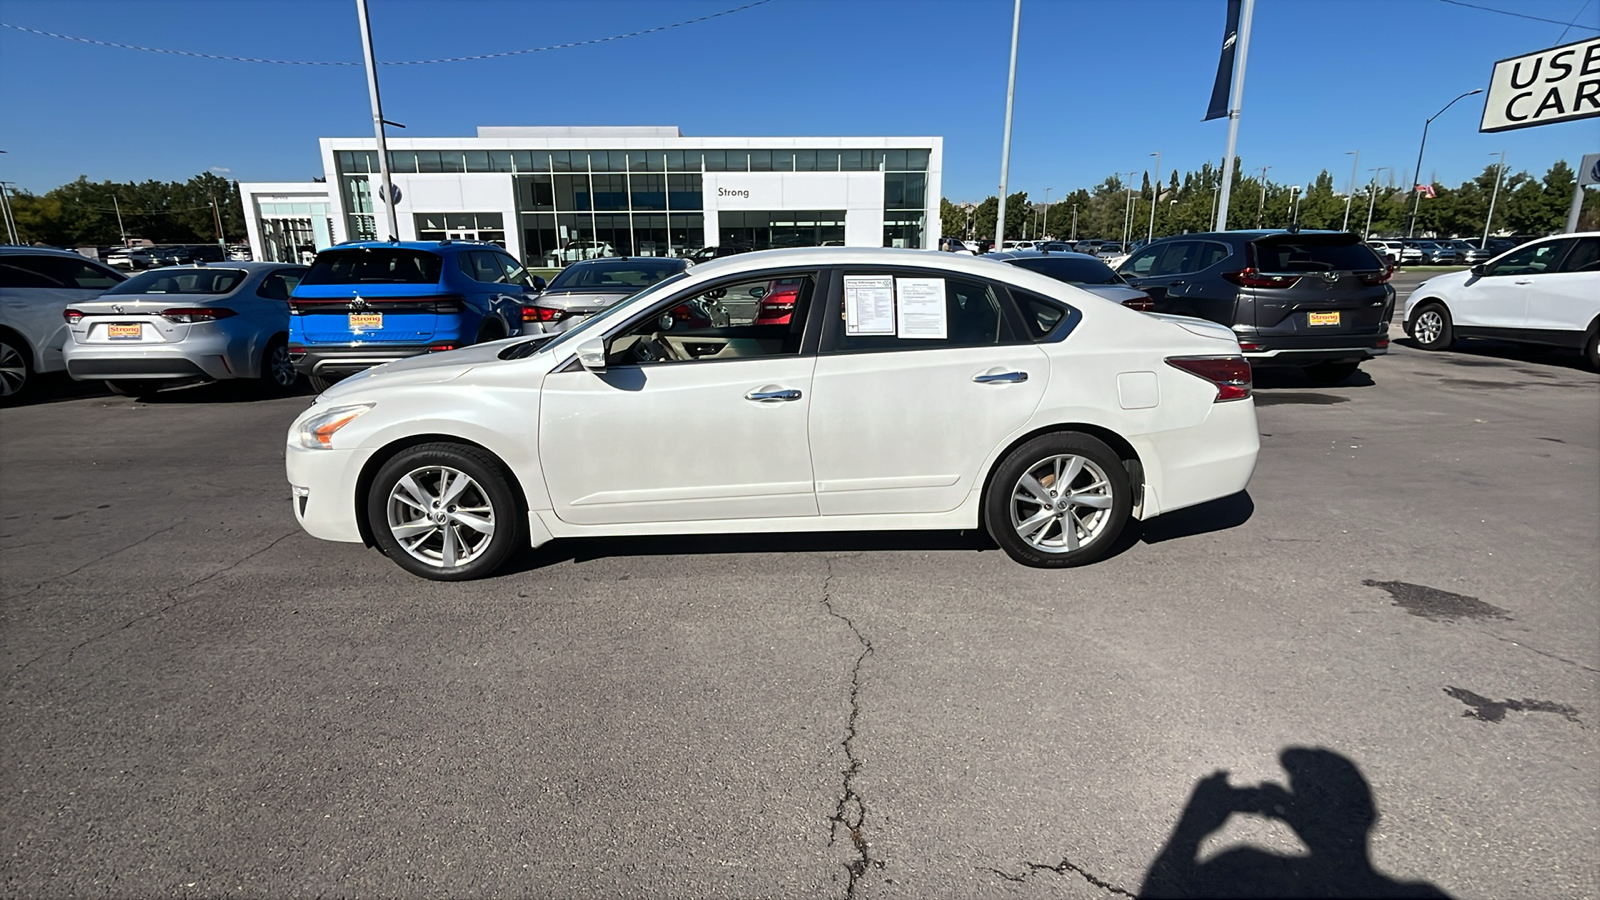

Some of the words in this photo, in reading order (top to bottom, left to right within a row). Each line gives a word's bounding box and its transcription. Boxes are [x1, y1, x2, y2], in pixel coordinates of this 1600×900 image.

[1510, 43, 1600, 89] USE
[1505, 79, 1600, 122] CAR
[717, 187, 749, 199] Strong
